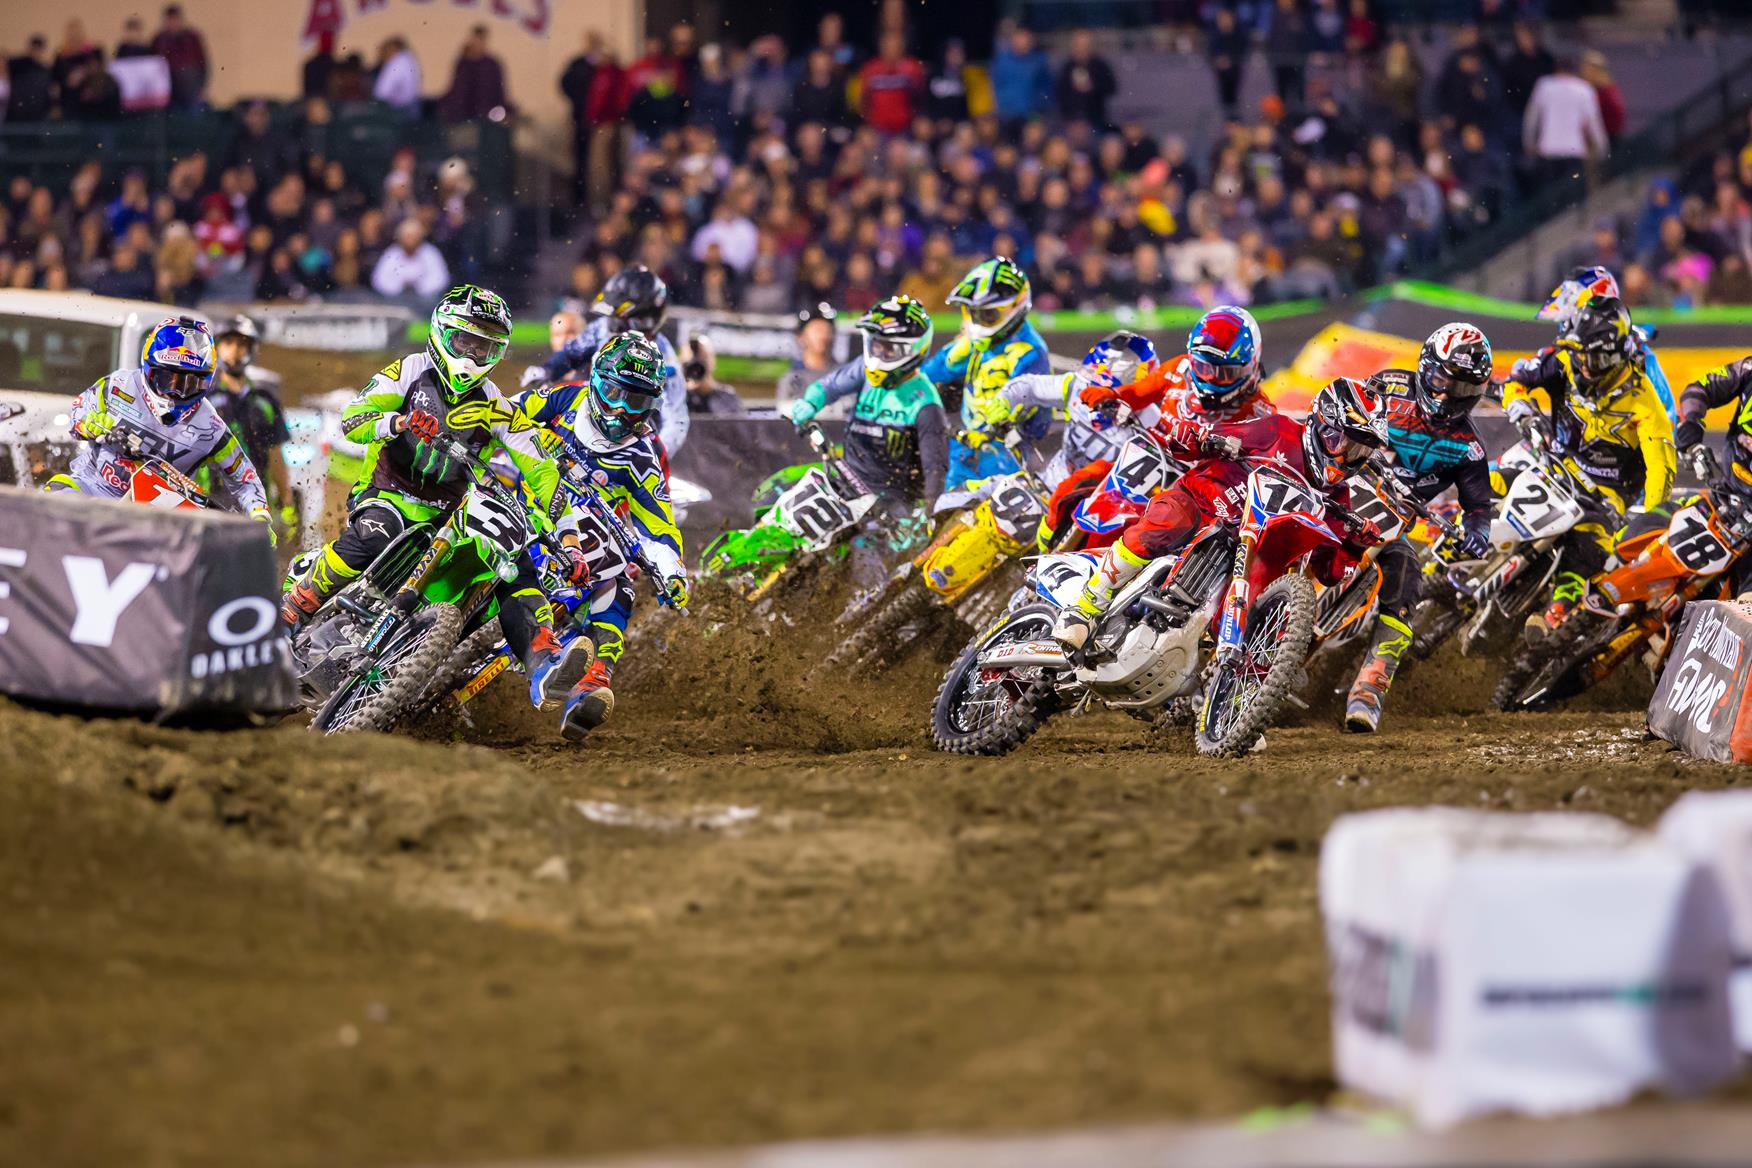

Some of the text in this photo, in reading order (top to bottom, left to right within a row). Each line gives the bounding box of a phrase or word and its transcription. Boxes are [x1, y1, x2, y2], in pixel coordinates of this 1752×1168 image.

[465, 499, 523, 552] 3
[785, 483, 842, 541] 12
[1511, 484, 1567, 532] 21
[1669, 516, 1728, 570] 18
[190, 637, 288, 679] OAKLEY
